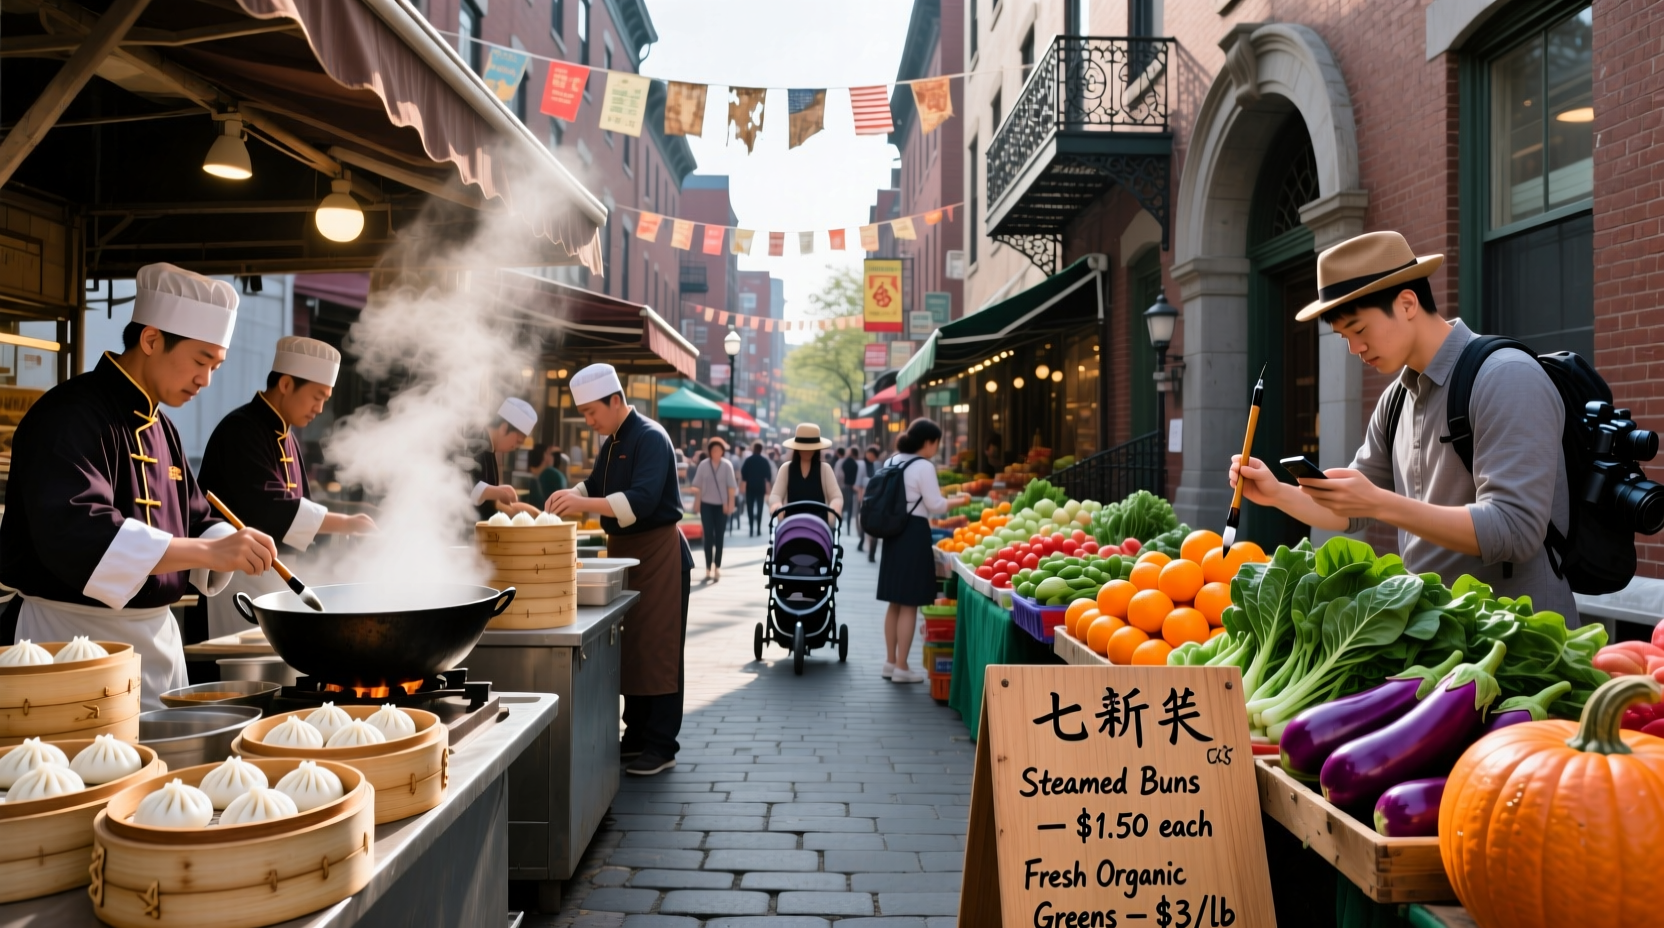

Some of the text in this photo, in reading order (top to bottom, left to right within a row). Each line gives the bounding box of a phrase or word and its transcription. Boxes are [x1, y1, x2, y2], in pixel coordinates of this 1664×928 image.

[1019, 765, 1201, 798] Steamed Buns
[1076, 807, 1149, 844] $1.50
[1158, 809, 1213, 838] each
[1024, 857, 1187, 900] Fresh Organic
[1033, 900, 1118, 928] Greens
[1155, 894, 1236, 928] $3/lb
